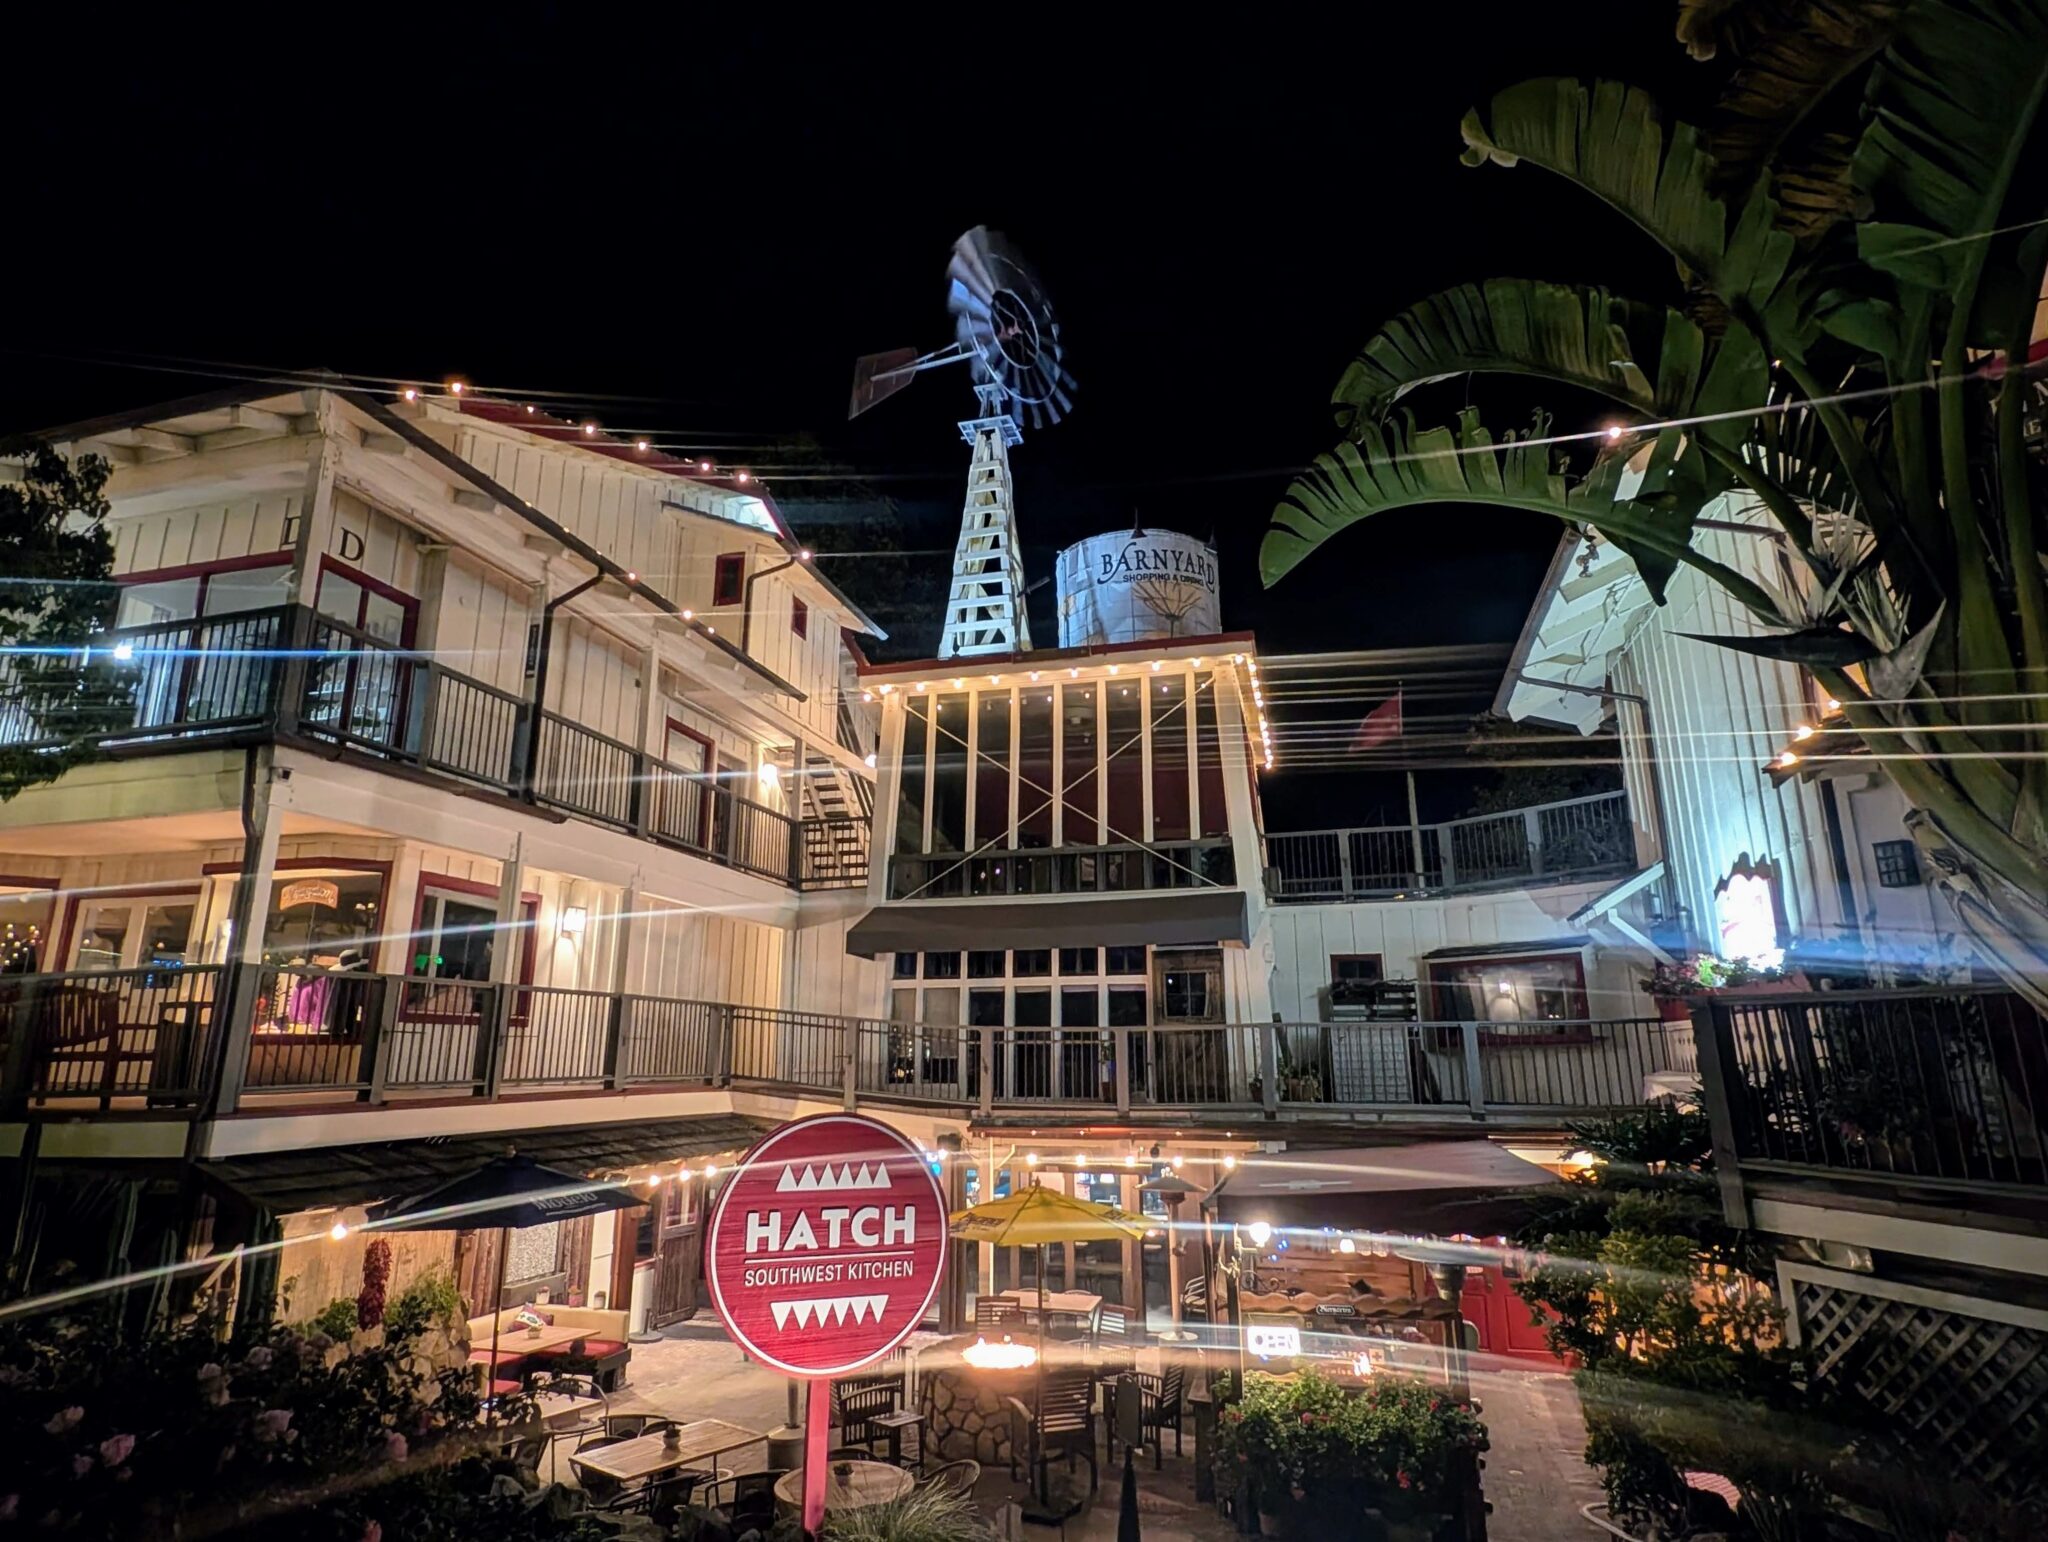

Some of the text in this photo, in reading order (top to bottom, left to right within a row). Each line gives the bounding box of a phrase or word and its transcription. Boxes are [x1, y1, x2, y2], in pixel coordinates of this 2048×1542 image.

[339, 527, 365, 561] D
[1097, 542, 1215, 594] BARNYARD
[1123, 573, 1171, 583] SHOPPING
[746, 1206, 916, 1253] HATCH
[745, 1260, 913, 1287] SOUTHWEST KITCHEN
